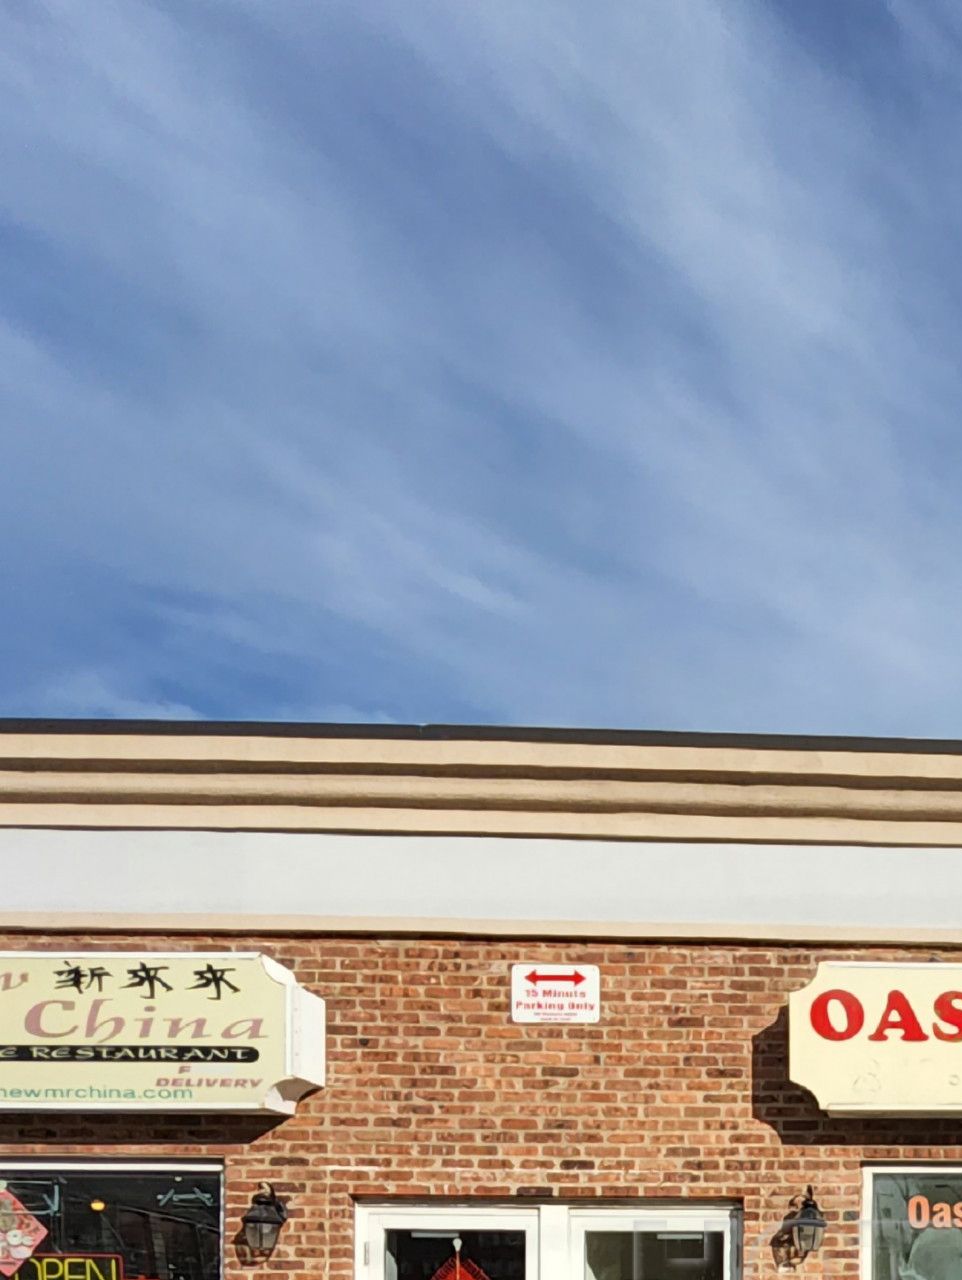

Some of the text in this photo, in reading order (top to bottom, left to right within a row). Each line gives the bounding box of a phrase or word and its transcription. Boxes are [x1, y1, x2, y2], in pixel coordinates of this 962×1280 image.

[525, 989, 538, 998] 15
[516, 1001, 595, 1011] Parking Only
[24, 998, 269, 1044] China
[155, 1078, 263, 1088] DELIVERY
